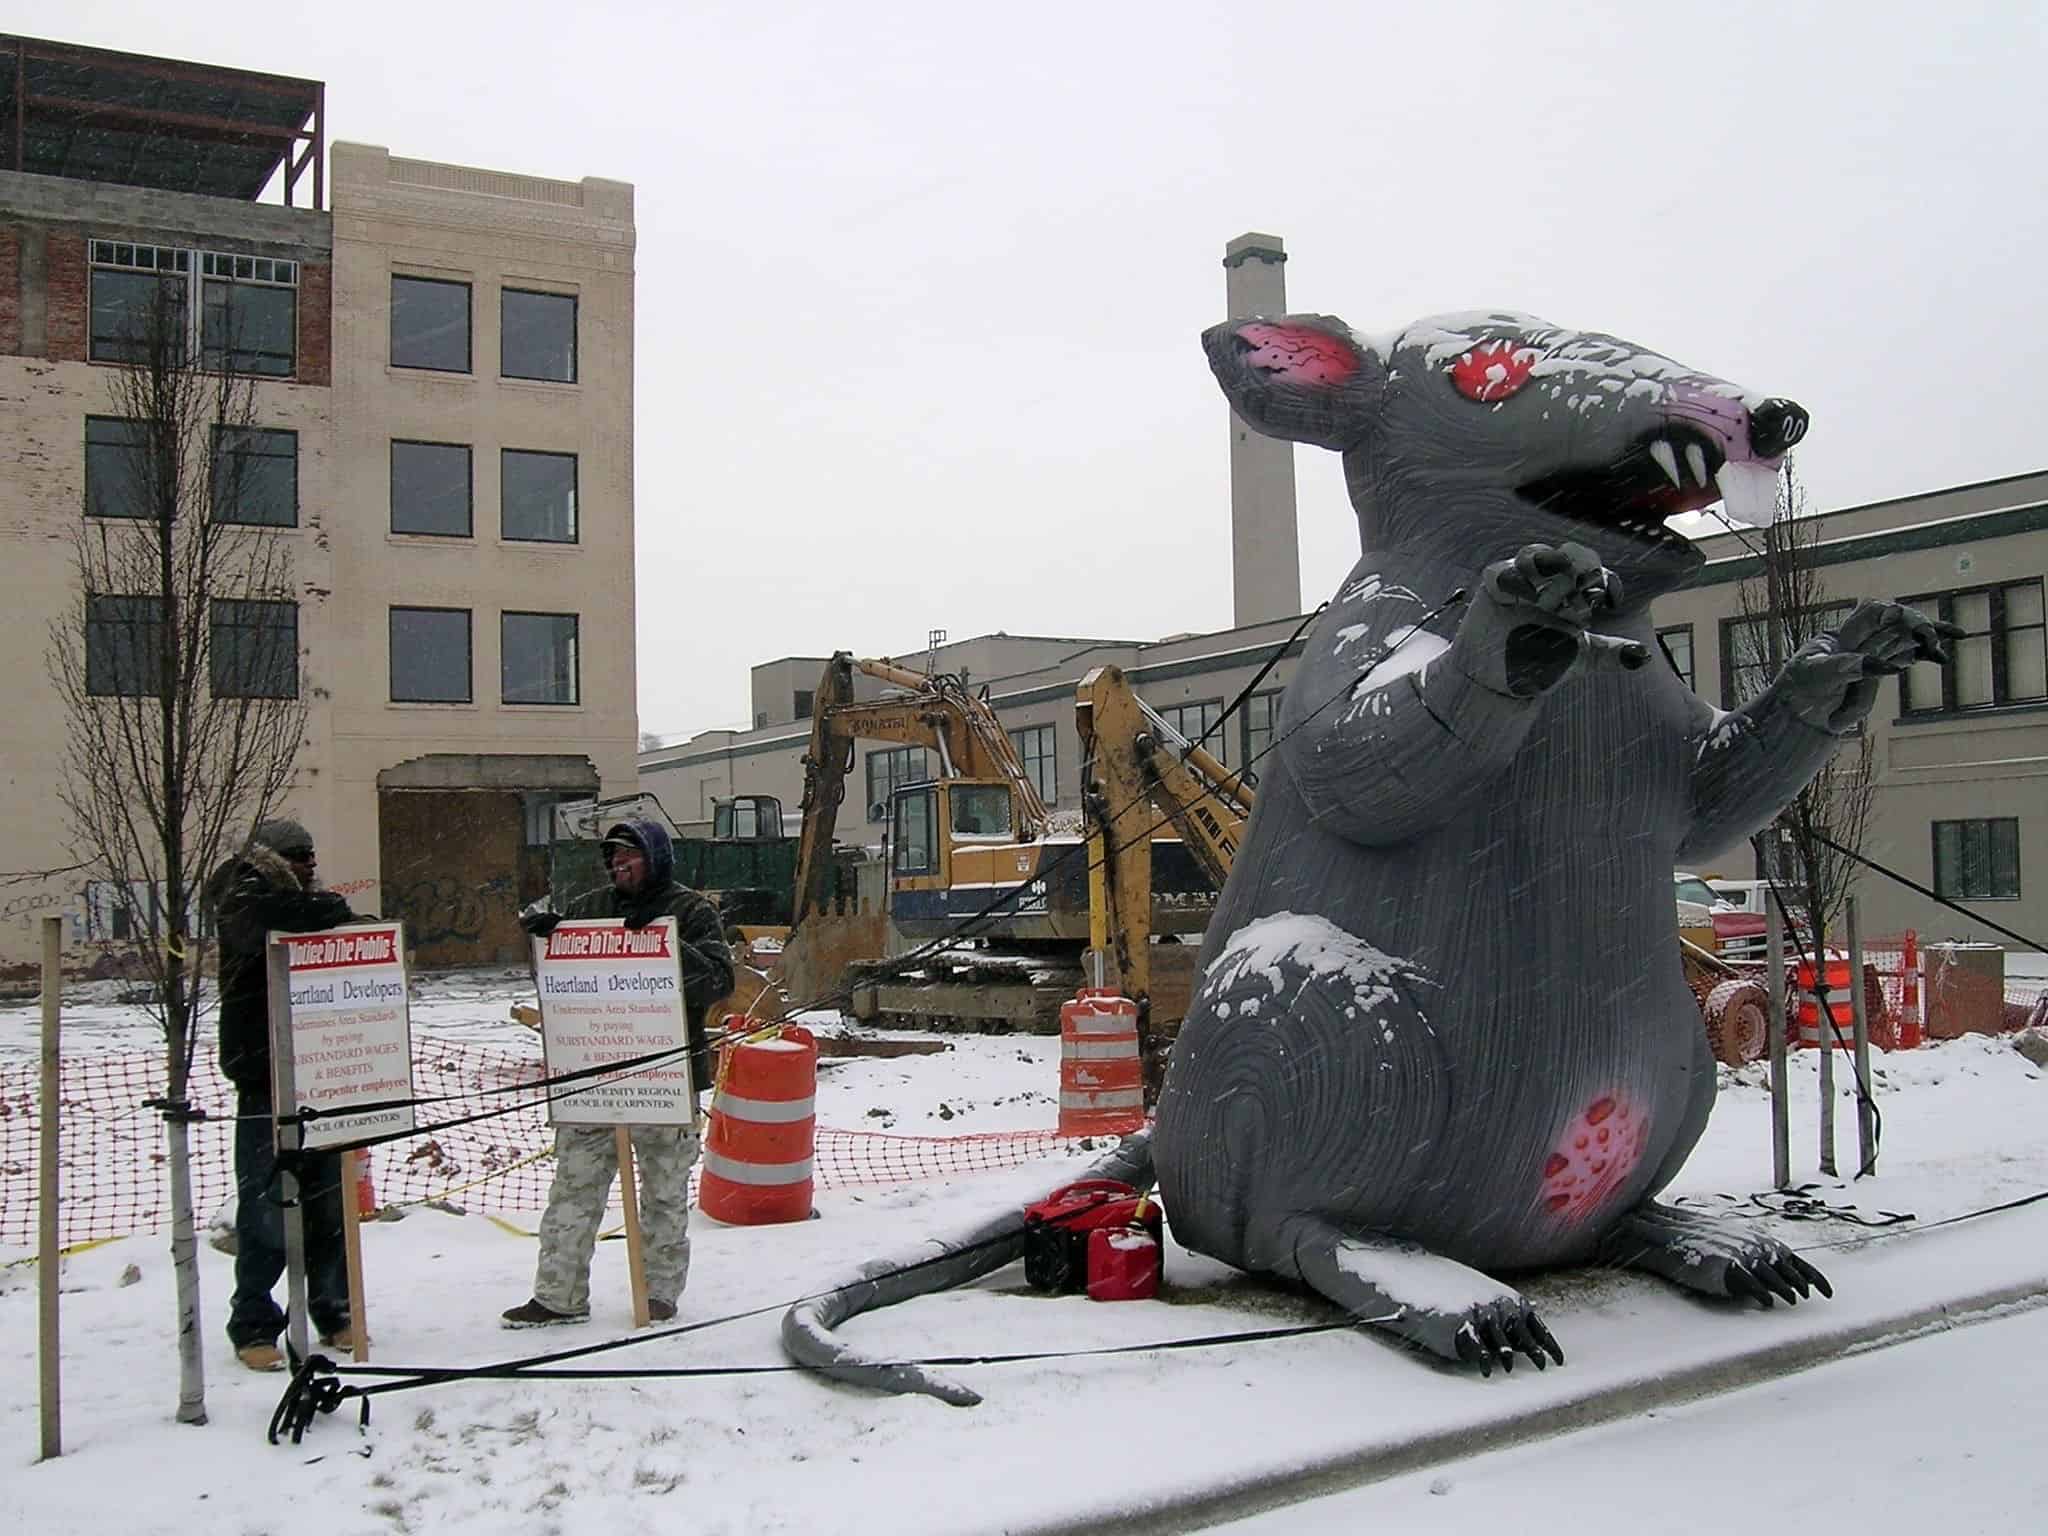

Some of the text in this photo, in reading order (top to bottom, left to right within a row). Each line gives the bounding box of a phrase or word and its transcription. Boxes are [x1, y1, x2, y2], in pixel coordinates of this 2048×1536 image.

[288, 936, 391, 966] Notice To The Public
[550, 930, 661, 955] Notice To The Public
[290, 979, 402, 1005] eartland Developers
[545, 971, 674, 995] Heartland Developers
[294, 1045, 364, 1066] UBSTANDARD
[326, 1062, 374, 1079] BENEFITS
[310, 1083, 359, 1099] Carpenter
[361, 1078, 408, 1093] employees
[637, 1086, 682, 1097] REGIONAL
[616, 1098, 674, 1109] CARPENTERS
[347, 1112, 400, 1127] CARPENTERS
